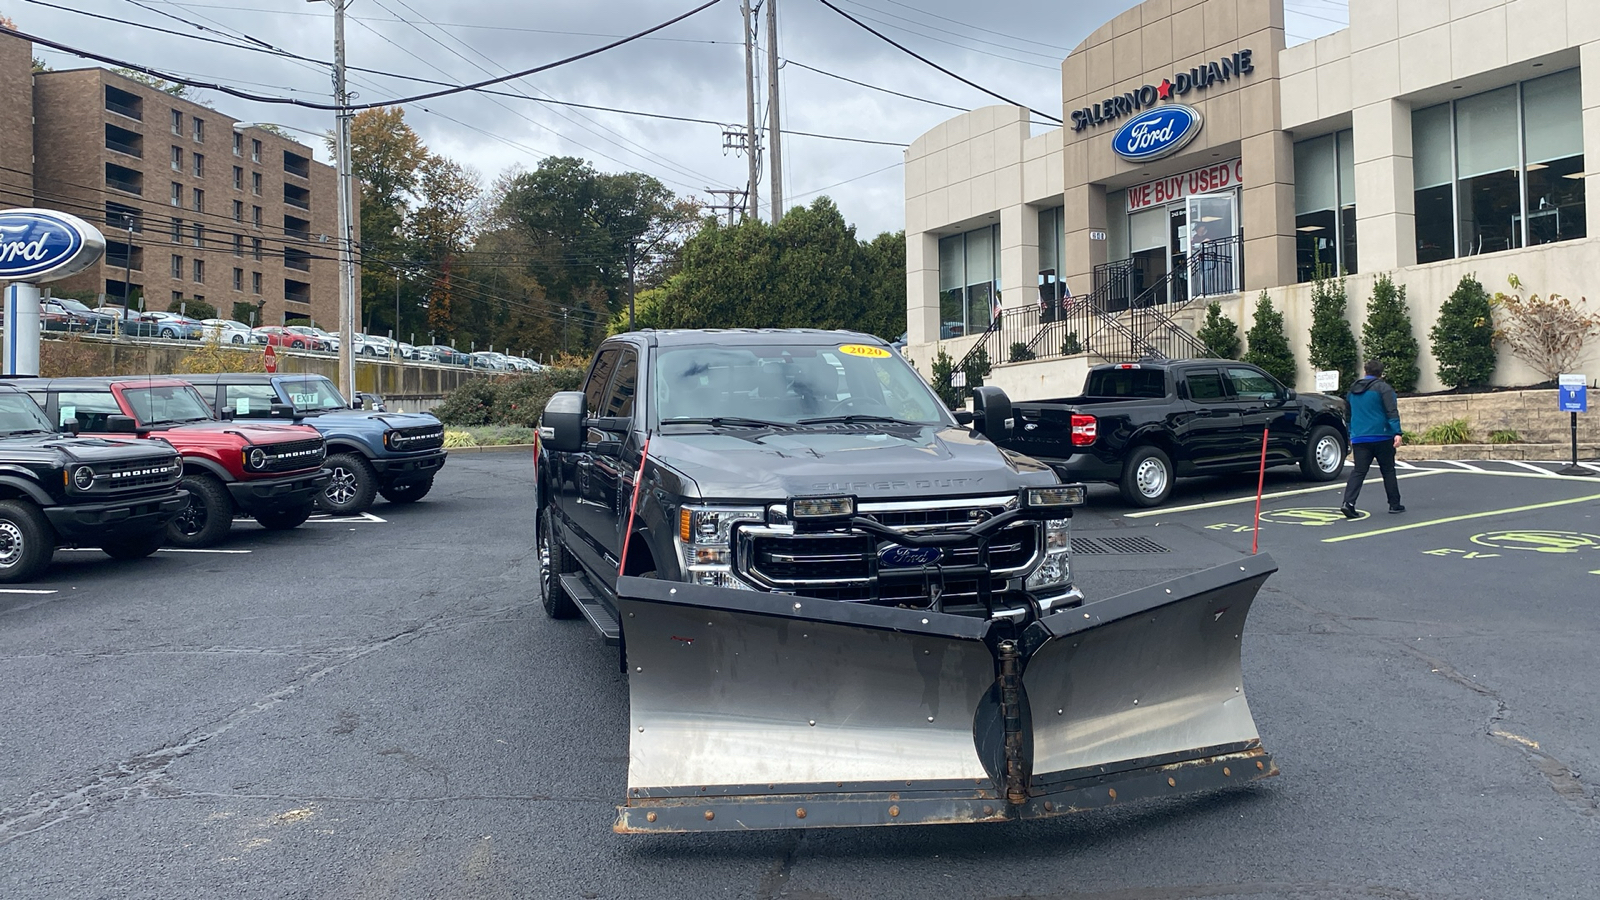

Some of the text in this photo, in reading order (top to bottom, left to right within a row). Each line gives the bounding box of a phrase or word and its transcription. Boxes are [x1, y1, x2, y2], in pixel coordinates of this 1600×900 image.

[1070, 49, 1254, 131] SALERNO DUANE
[1127, 117, 1175, 152] Ford
[1129, 184, 1151, 209] WE
[1155, 175, 1184, 203] BUY
[1189, 164, 1230, 194] USED
[849, 346, 882, 356] 2020
[265, 355, 276, 367] STOP
[296, 394, 314, 403] EXIT
[277, 449, 317, 459] BRONCO
[112, 466, 168, 478] BRONCO
[812, 477, 984, 491] SUPER DUTY
[892, 547, 929, 564] Ford
